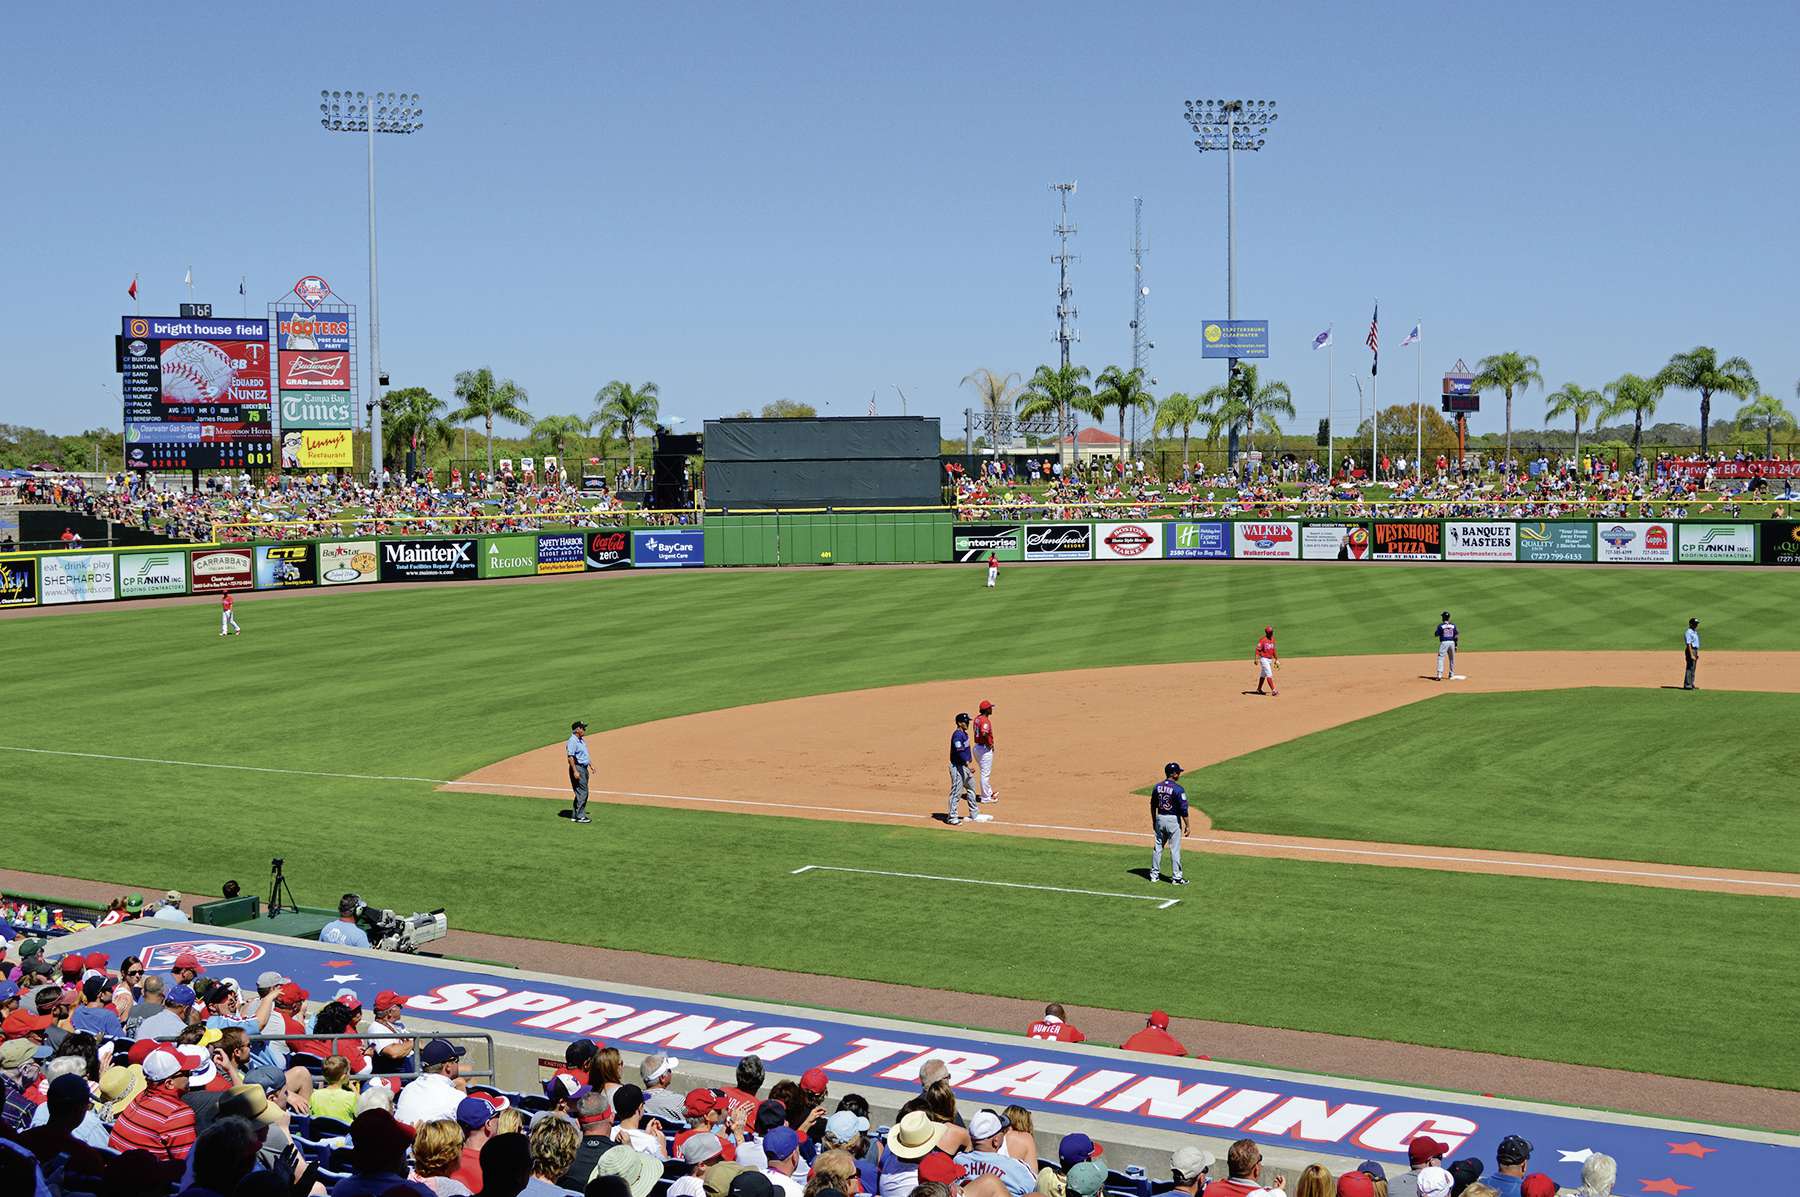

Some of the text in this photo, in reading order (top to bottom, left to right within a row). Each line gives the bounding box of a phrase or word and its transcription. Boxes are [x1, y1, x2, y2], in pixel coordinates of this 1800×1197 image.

[154, 323, 263, 336] bright house field
[280, 320, 348, 336] HOOTERS
[230, 359, 248, 370] 3B
[288, 359, 341, 370] Budweiser
[232, 378, 264, 386] EDUARDO
[228, 387, 268, 400] NUNEZ
[282, 396, 350, 422] Times
[306, 432, 345, 450] Lenny's
[1670, 464, 1721, 475] Clearwaer
[1724, 464, 1737, 474] ER
[1748, 464, 1776, 475] Oen
[1113, 527, 1144, 536] BOSTON
[1240, 524, 1288, 536] WALKER
[1375, 524, 1439, 544] WESTSHORE
[1462, 527, 1511, 538] BANQUET
[540, 537, 583, 547] SAFETY HARBOR
[592, 533, 625, 552] Coca-Cola
[957, 538, 1016, 548] enterprise
[1027, 528, 1090, 553] Sandpearl
[1462, 538, 1511, 547] MASTERS
[1521, 540, 1554, 548] QUALITY
[322, 549, 337, 557] Bay
[658, 543, 693, 552] BayCare
[1113, 545, 1144, 554] MARKET
[1388, 542, 1426, 554] PIZZA
[600, 551, 618, 560] zero
[64, 560, 88, 570] drink
[93, 560, 110, 570] play
[196, 556, 248, 570] CARRABBA'S
[491, 556, 533, 569] REGIONS
[44, 573, 112, 586] SHEPHARD'S
[123, 577, 135, 586] CP
[137, 576, 170, 585] RANKIN
[409, 982, 823, 1060] SPRING
[1033, 1024, 1061, 1034] HUNTER
[826, 1036, 1477, 1160] TRAINING
[956, 1161, 1006, 1182] CHMIDT
